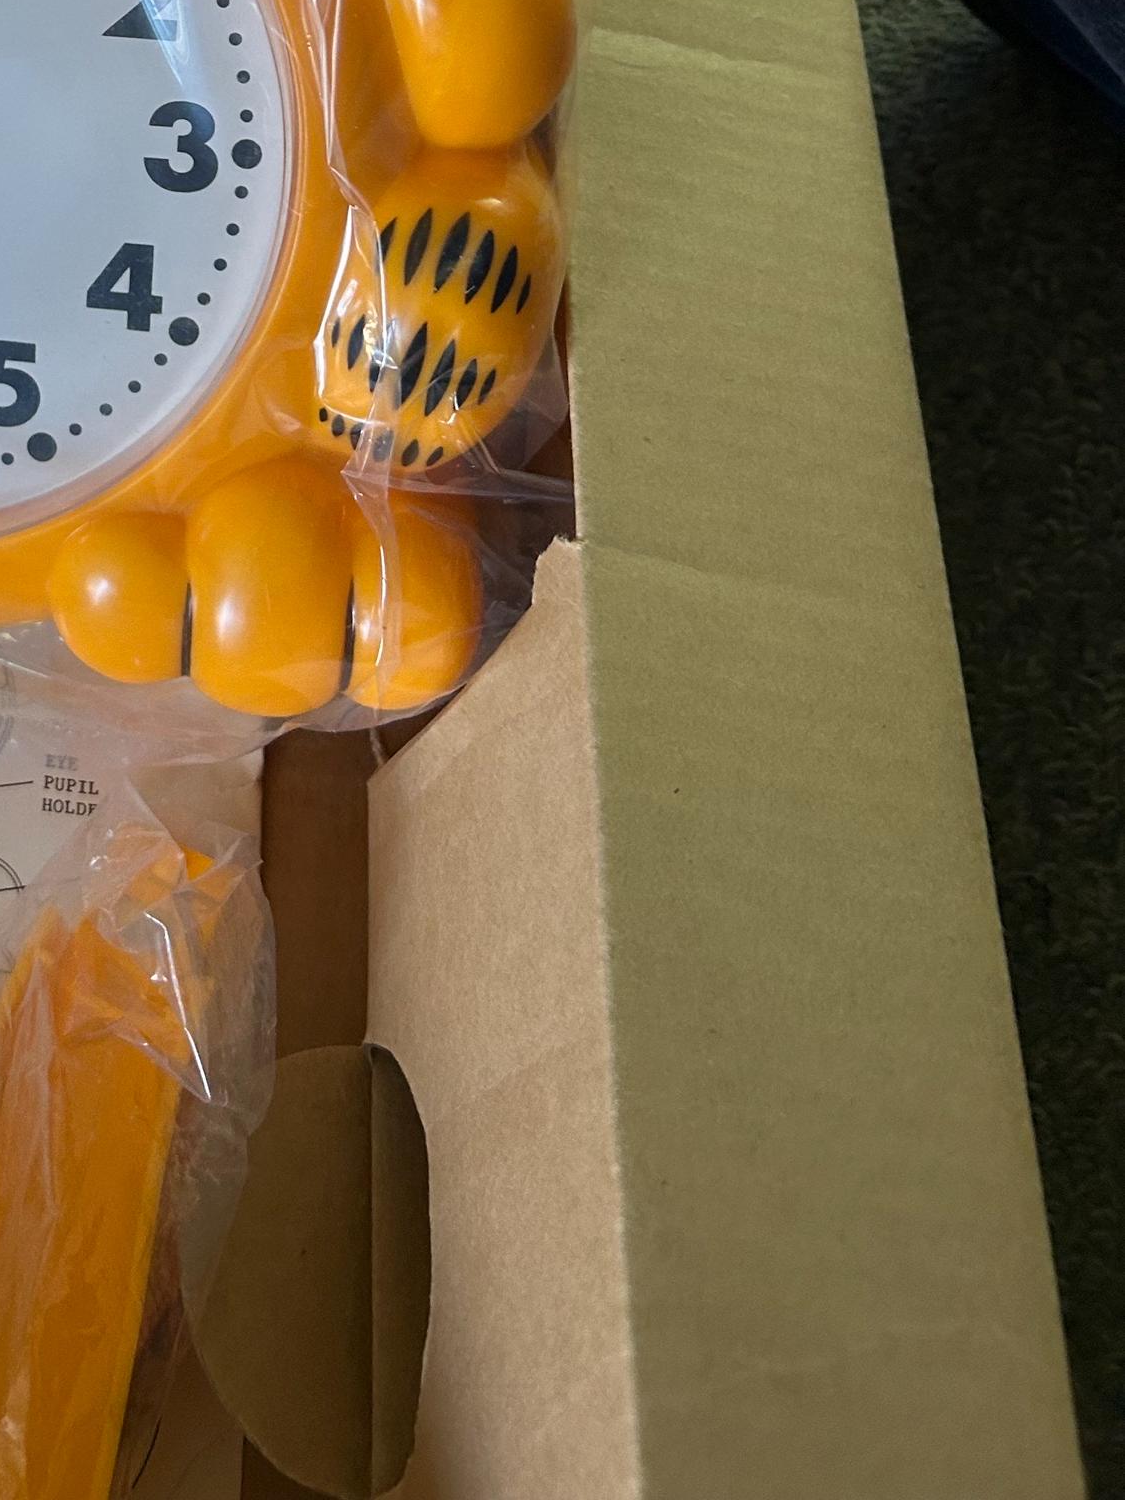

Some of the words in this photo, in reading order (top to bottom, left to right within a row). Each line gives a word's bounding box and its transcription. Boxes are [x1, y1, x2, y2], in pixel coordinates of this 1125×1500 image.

[143, 101, 219, 192] 3
[86, 243, 163, 332] 4
[44, 753, 78, 771] EYE
[43, 775, 99, 795] PUPIL
[42, 797, 98, 816] HOLDE
